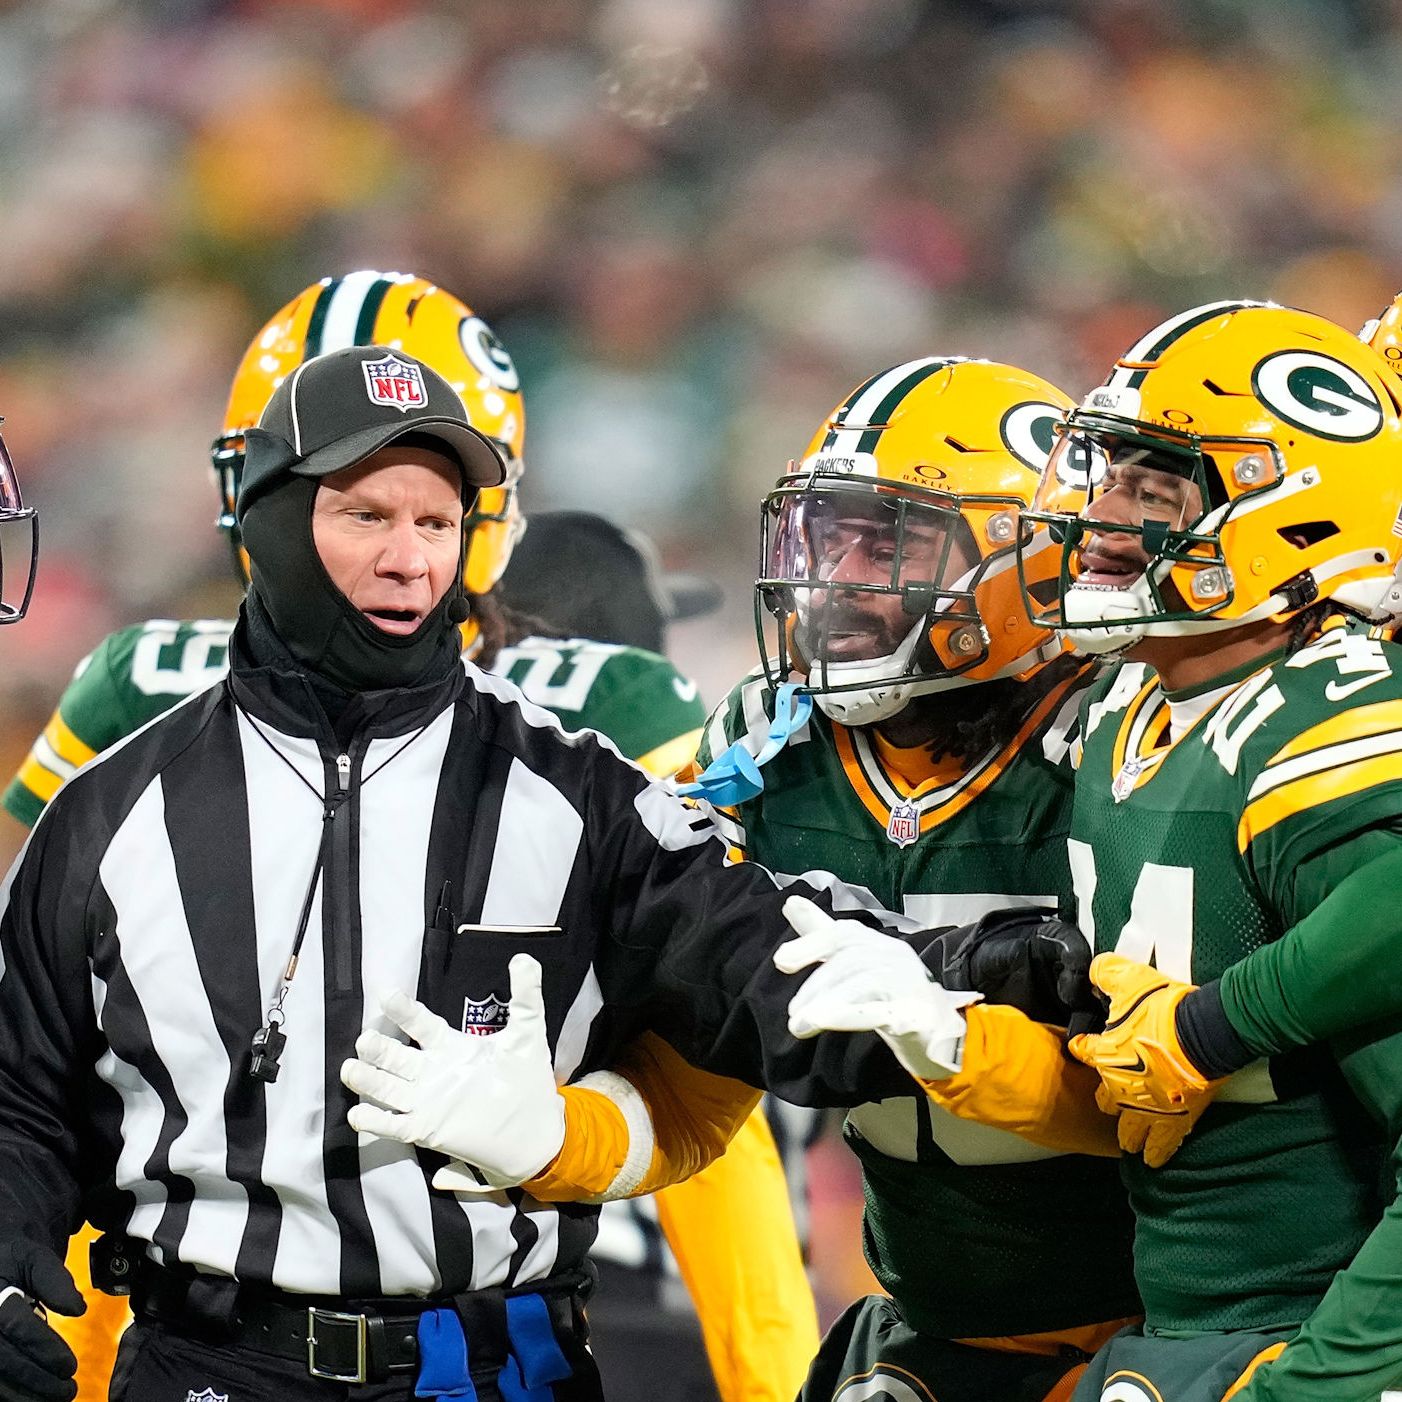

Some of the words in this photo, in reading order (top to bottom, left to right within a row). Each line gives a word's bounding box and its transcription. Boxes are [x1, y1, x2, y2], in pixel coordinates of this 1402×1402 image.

[375, 378, 420, 403] NFL
[1251, 349, 1384, 444] G
[892, 819, 914, 839] NFL
